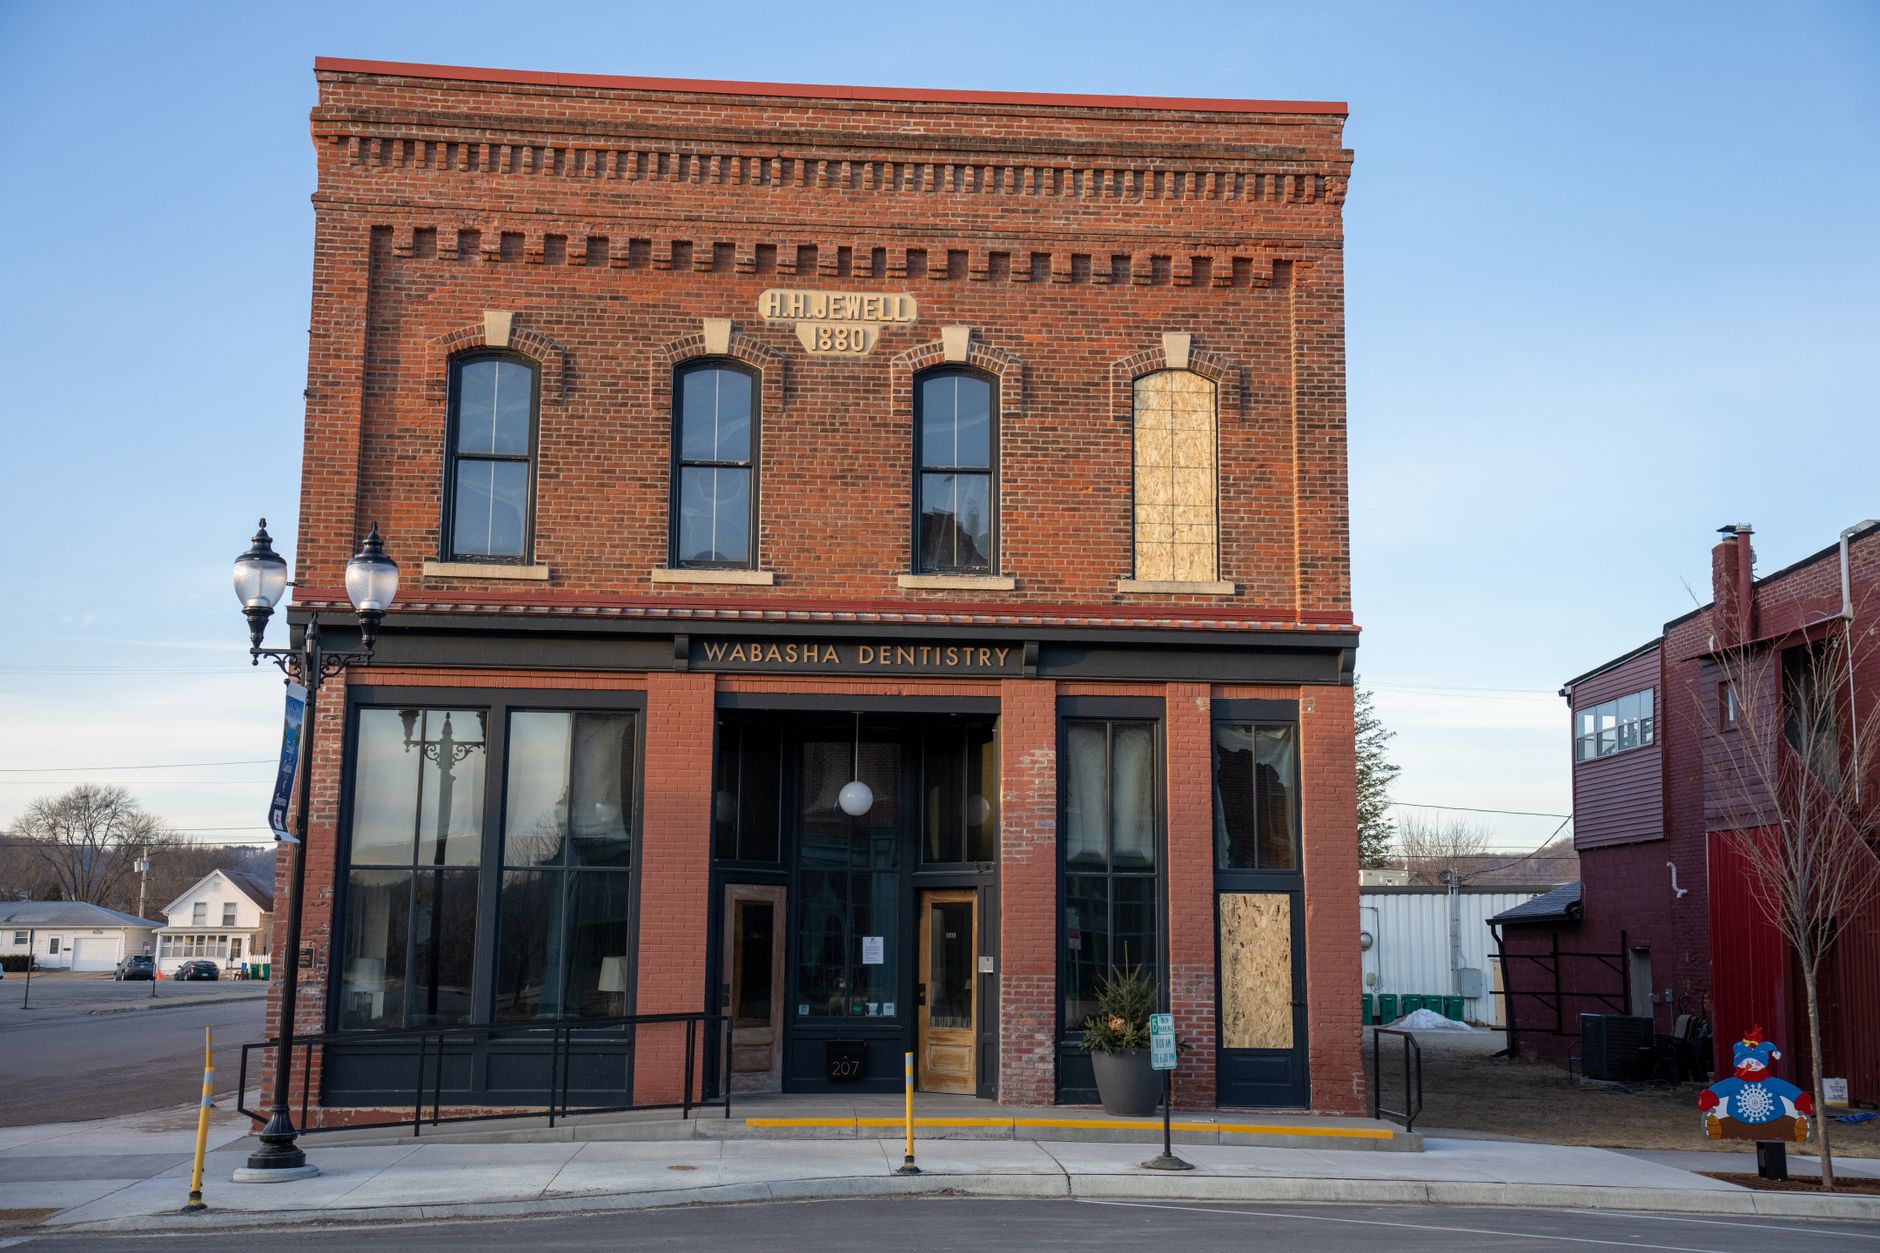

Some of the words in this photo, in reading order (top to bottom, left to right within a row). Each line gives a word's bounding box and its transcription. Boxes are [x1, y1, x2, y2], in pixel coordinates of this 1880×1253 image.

[812, 326, 865, 352] 1880
[703, 641, 841, 664] WABASHA
[859, 645, 1010, 667] DENTISTRY
[831, 1060, 860, 1077] 207
